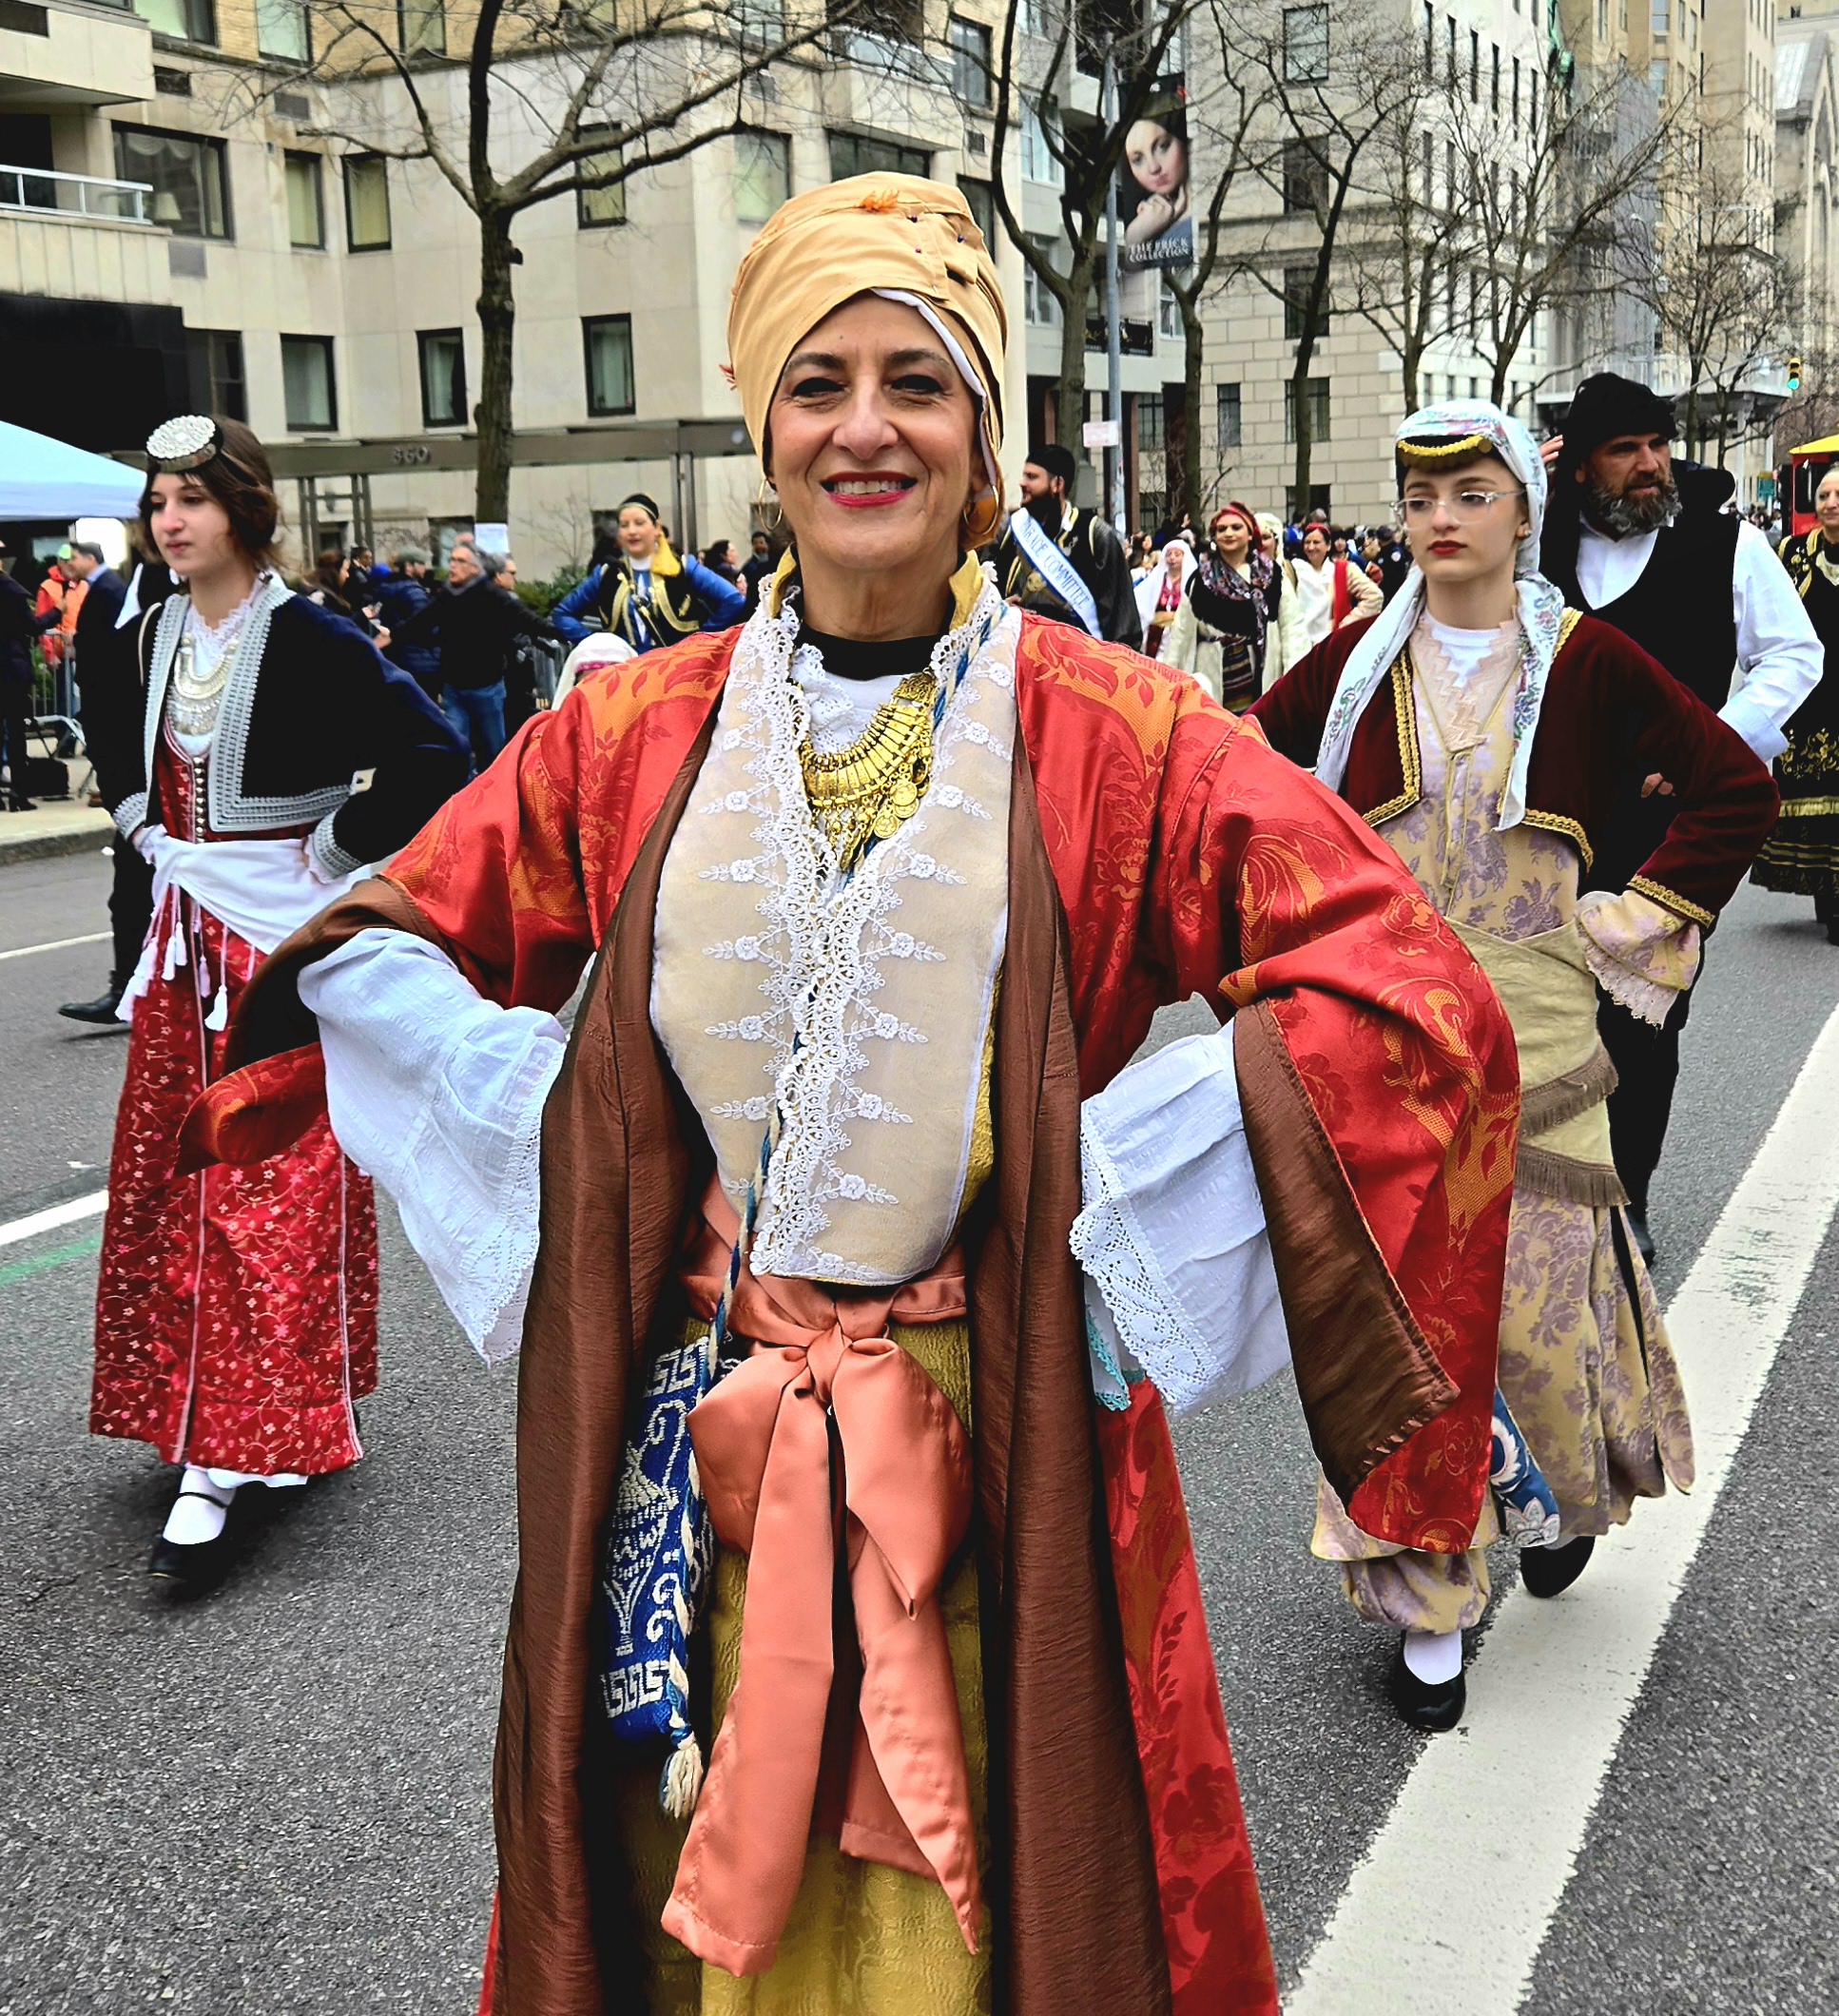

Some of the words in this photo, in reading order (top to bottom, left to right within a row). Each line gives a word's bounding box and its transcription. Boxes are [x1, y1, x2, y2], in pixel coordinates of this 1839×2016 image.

[1129, 240, 1152, 253] THE
[1154, 237, 1189, 251] FRICK
[1129, 246, 1190, 262] COLLECTION
[1019, 517, 1049, 558] PARADE
[1043, 553, 1091, 610] COMMITTEE
